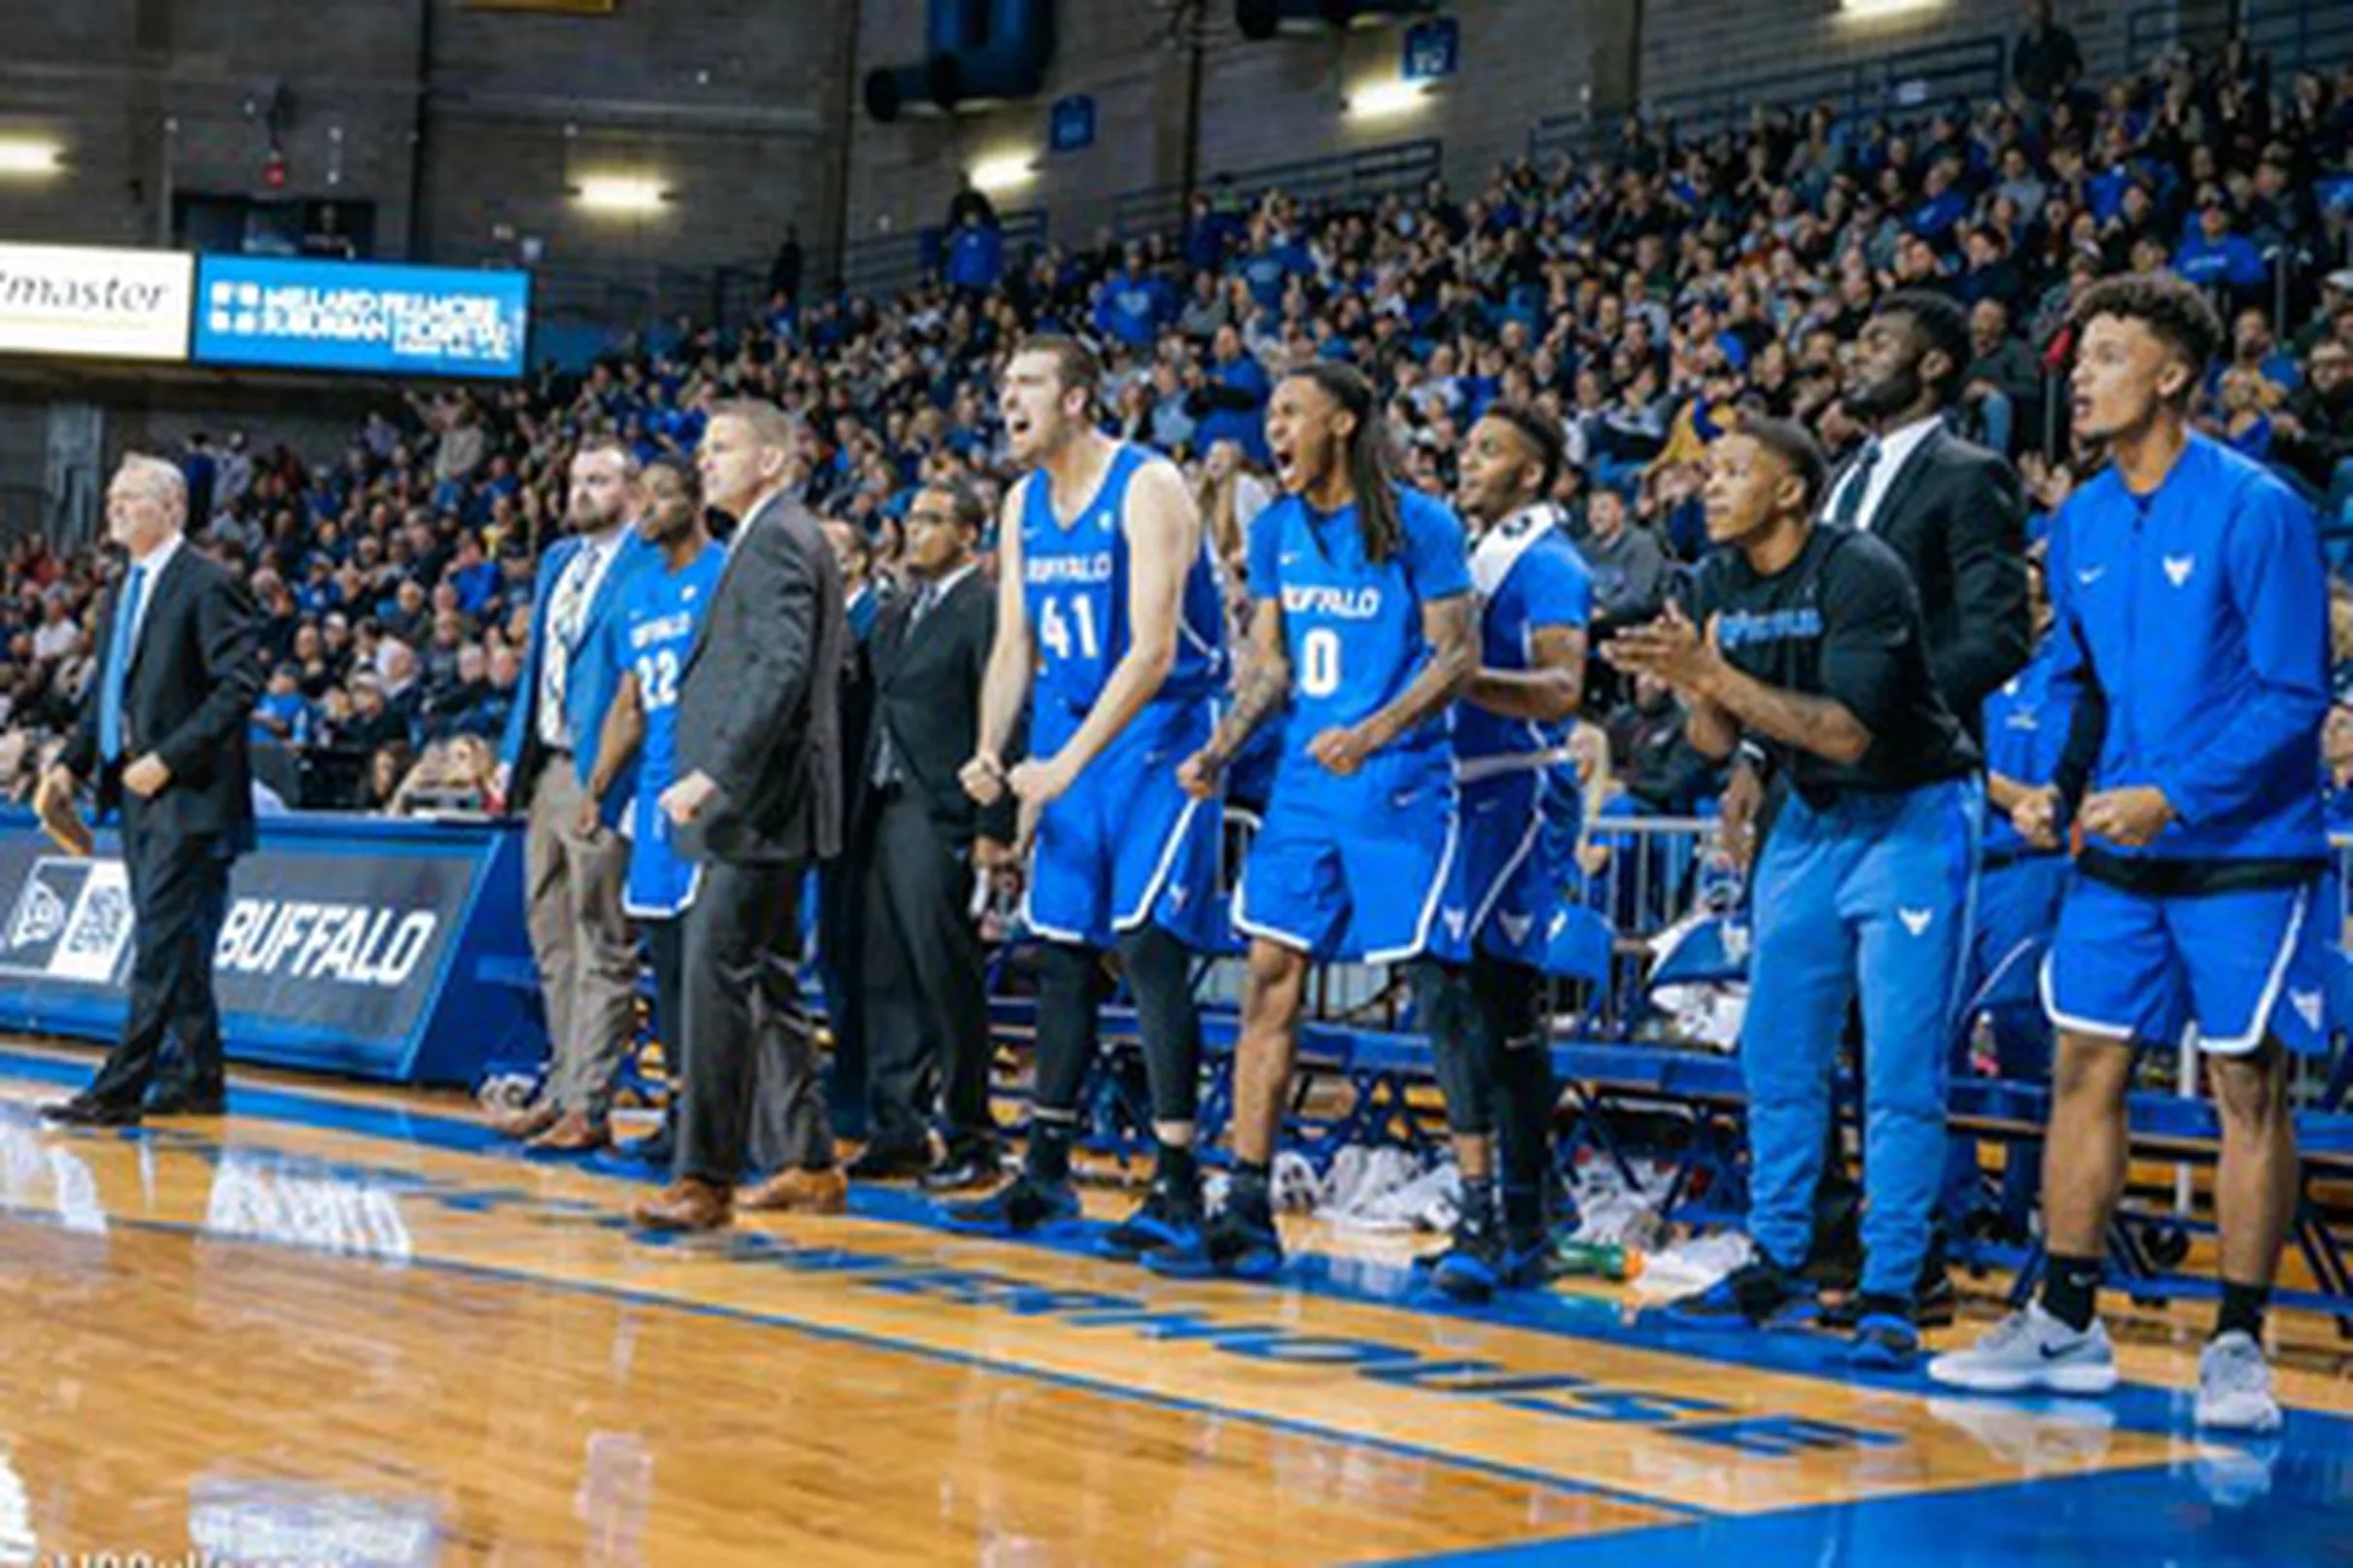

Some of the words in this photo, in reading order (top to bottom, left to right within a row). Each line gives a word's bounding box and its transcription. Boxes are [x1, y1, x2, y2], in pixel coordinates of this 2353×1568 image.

[0, 268, 170, 312] master
[1039, 594, 1097, 658] 41
[1302, 627, 1340, 696] 0
[213, 898, 436, 987] BUFFALO
